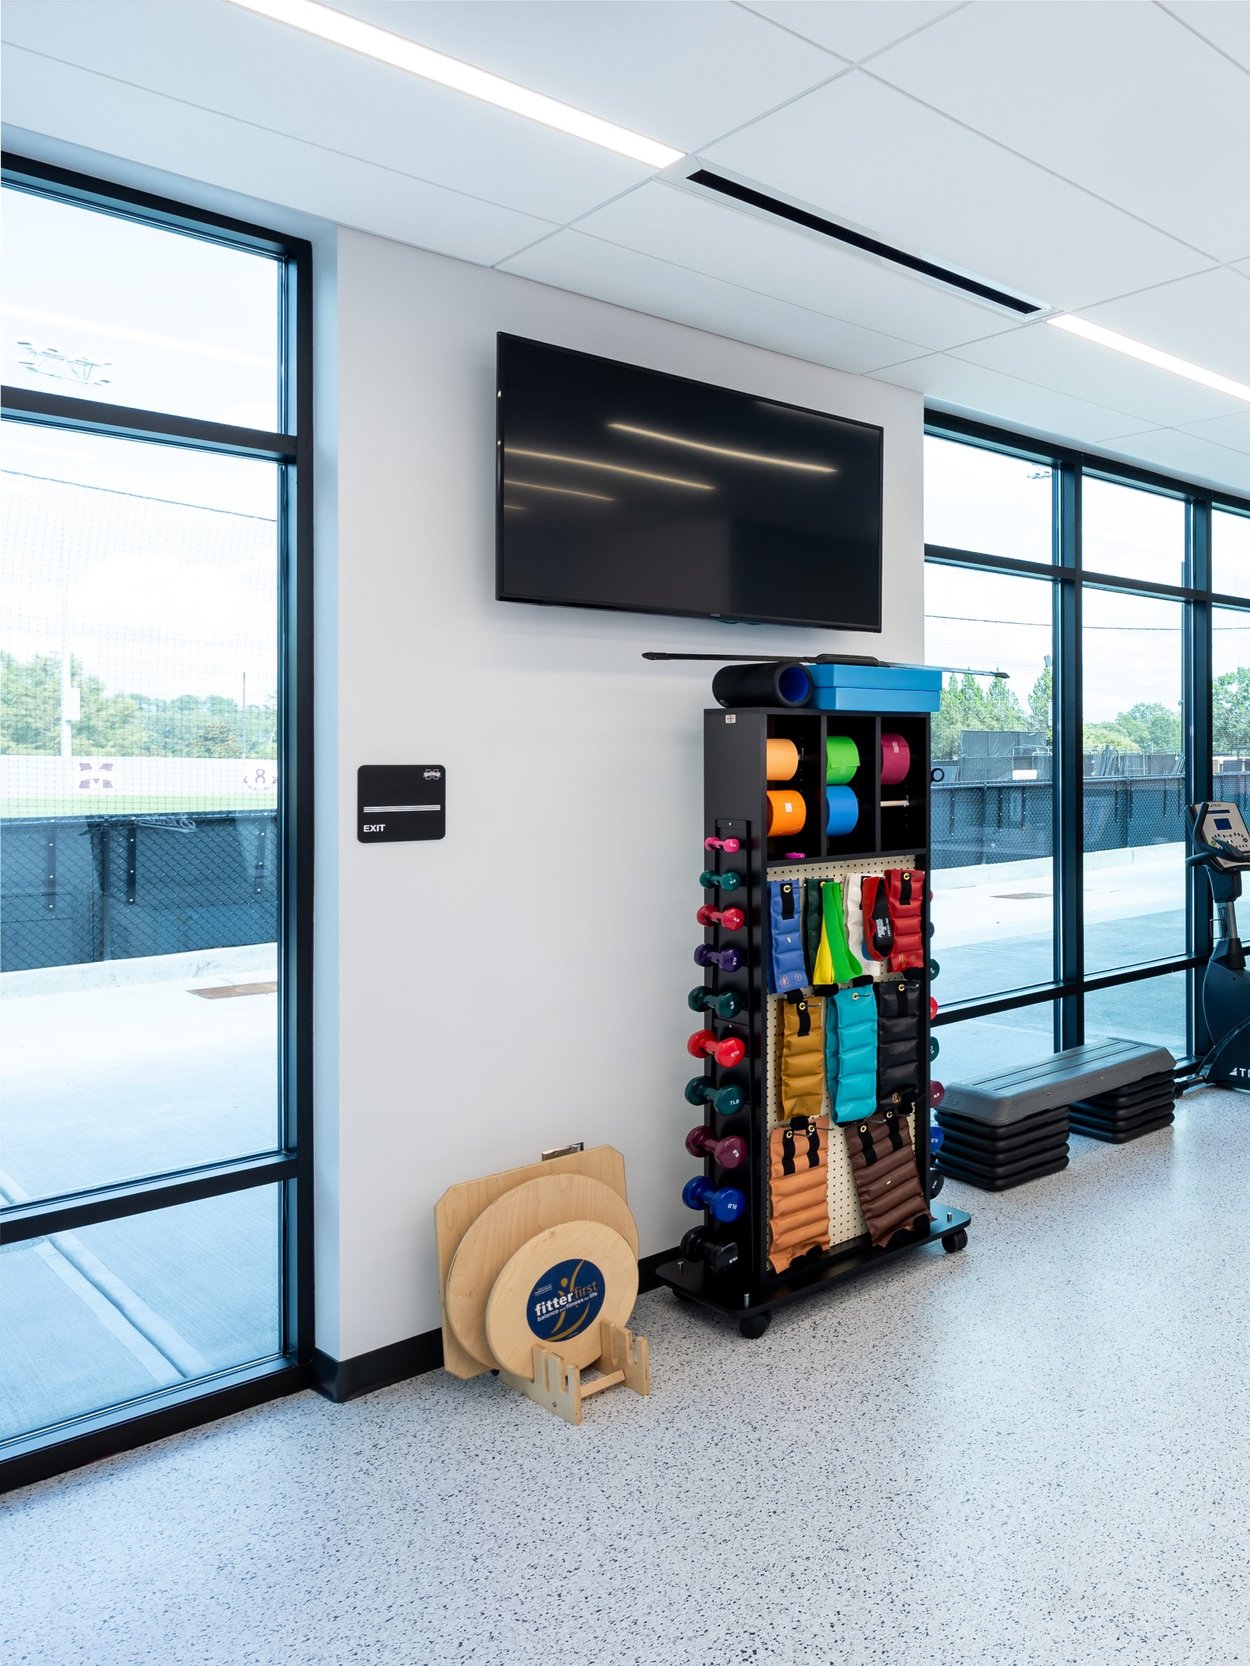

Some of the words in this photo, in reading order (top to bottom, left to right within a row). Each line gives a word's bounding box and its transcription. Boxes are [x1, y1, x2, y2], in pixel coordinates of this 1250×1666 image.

[255, 768, 265, 784] 8
[363, 824, 386, 832] EXIT
[537, 1309, 559, 1322] balance
[566, 1298, 584, 1309] fitness
